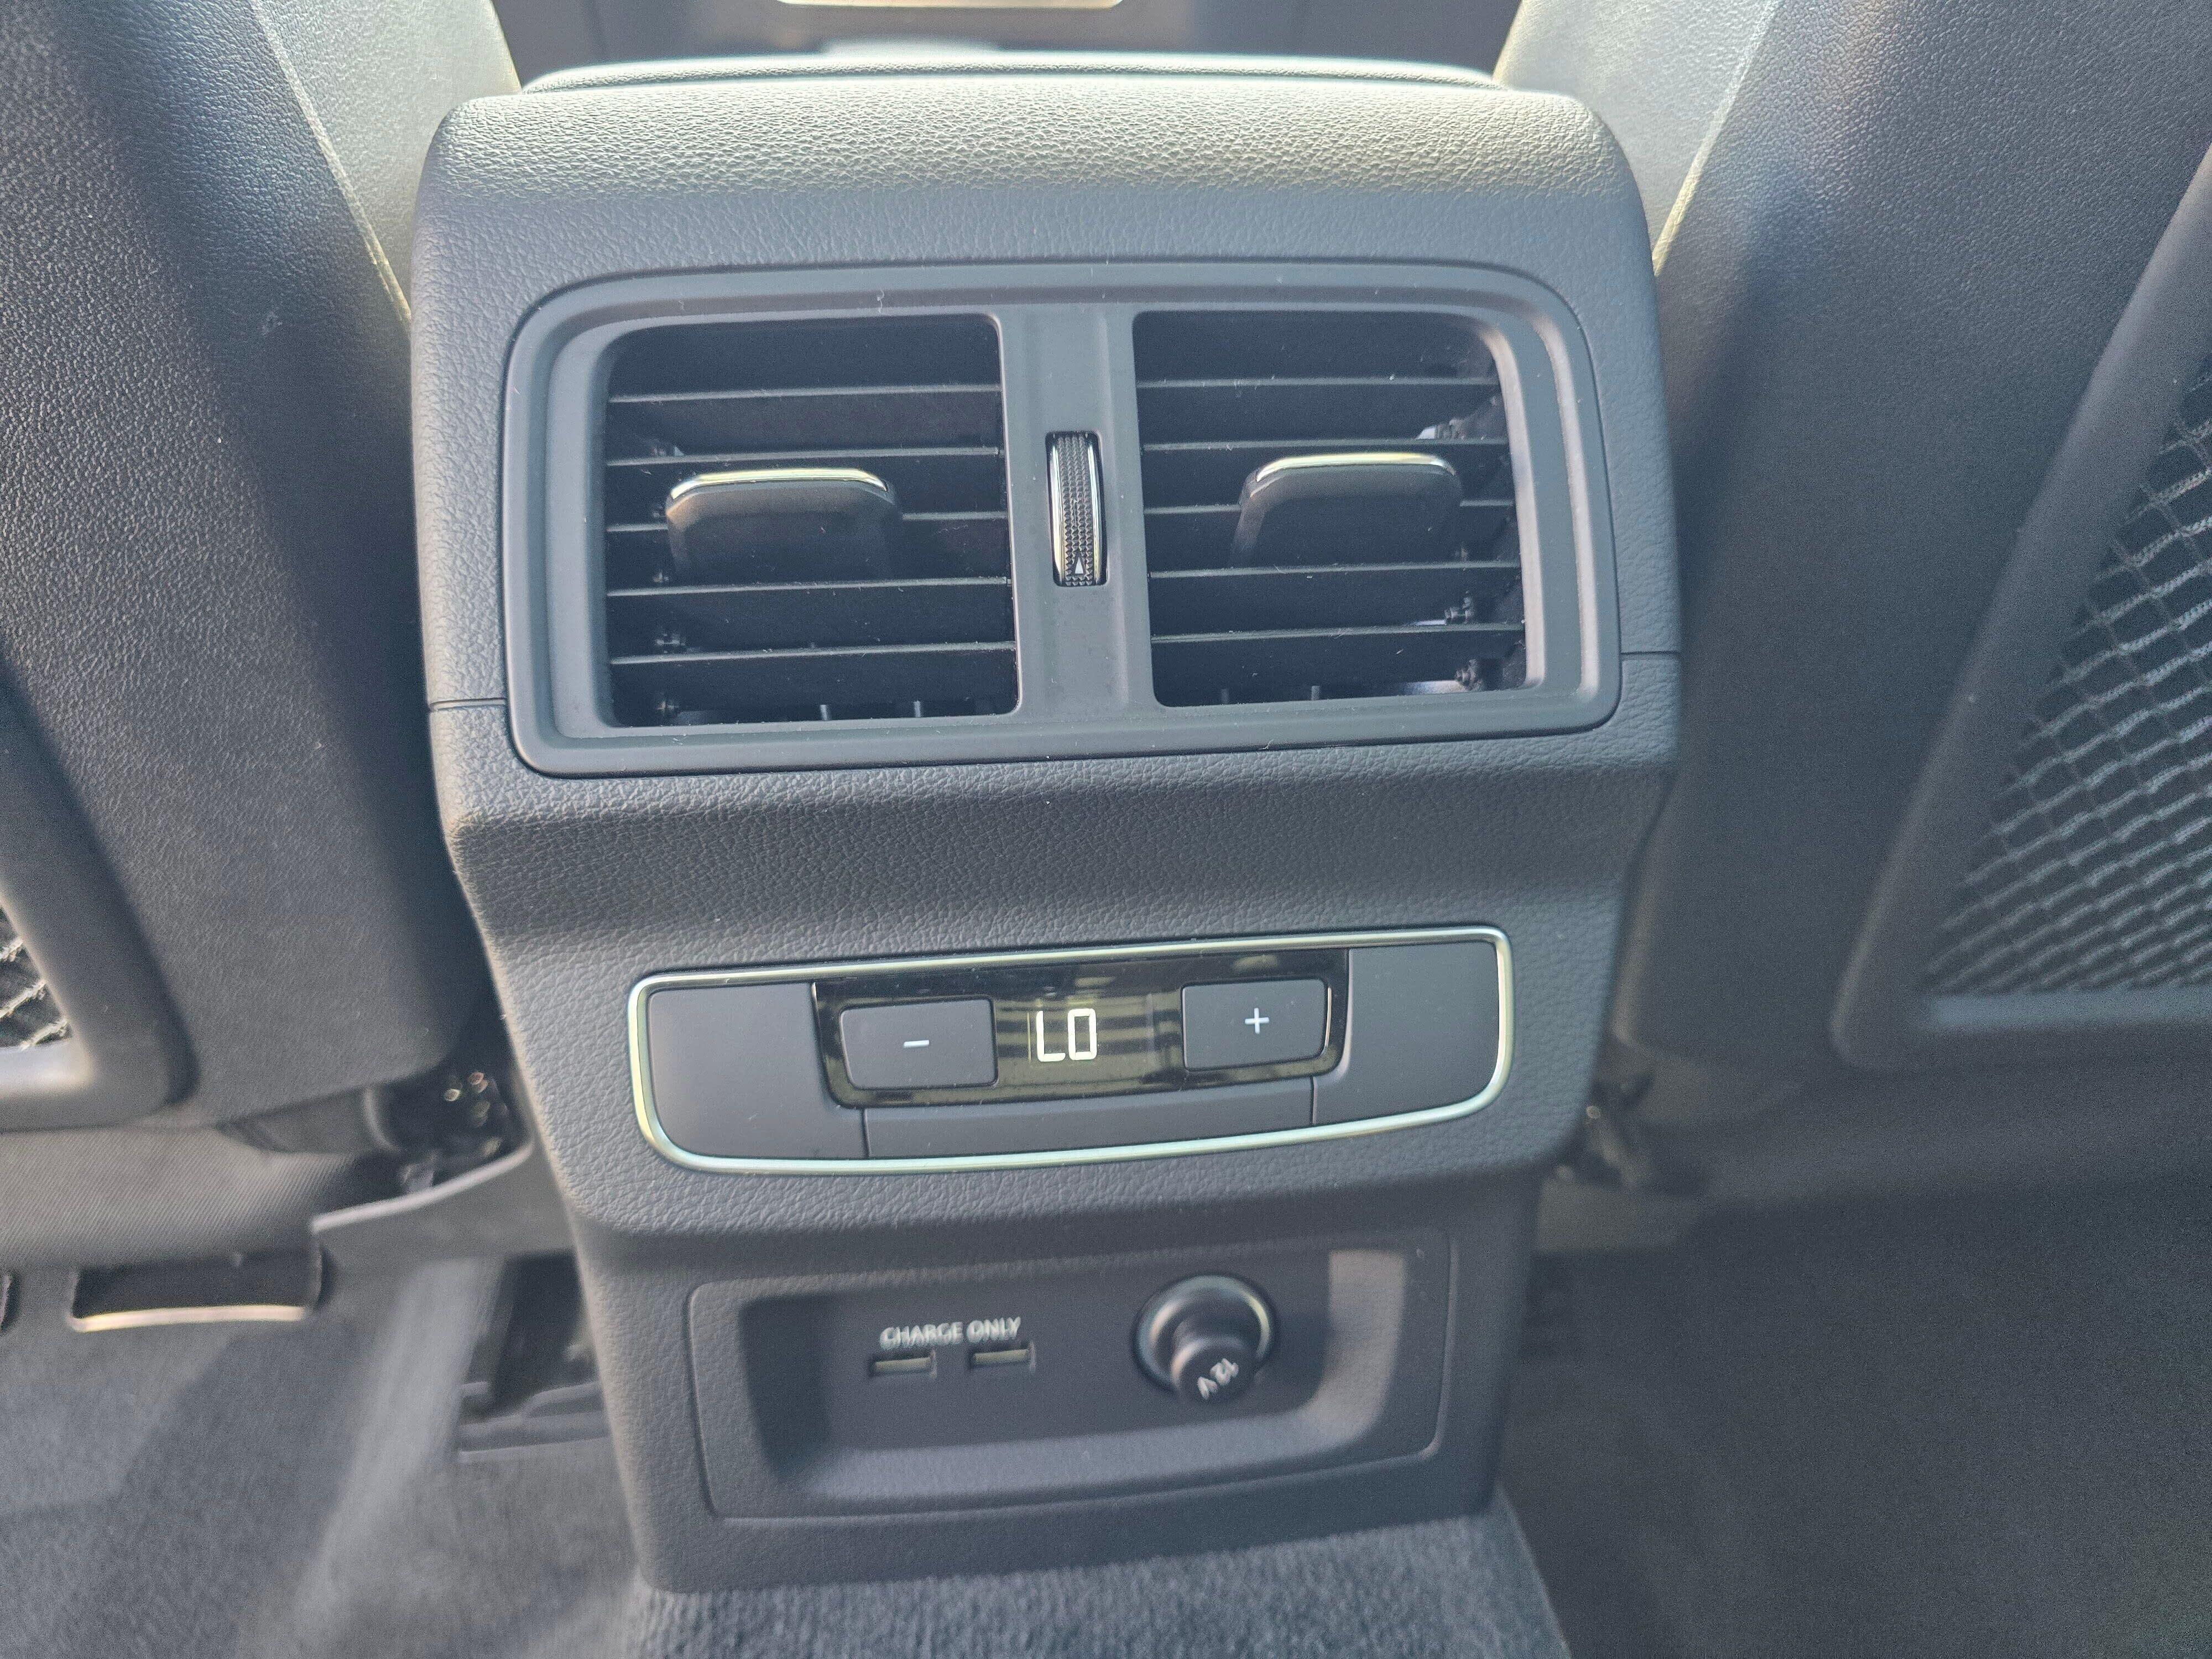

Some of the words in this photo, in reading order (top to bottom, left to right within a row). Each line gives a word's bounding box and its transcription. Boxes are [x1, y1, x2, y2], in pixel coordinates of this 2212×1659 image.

[1036, 1008, 1097, 1062] LO
[880, 1321, 964, 1350] CHARGE
[966, 1316, 1021, 1343] ONLY
